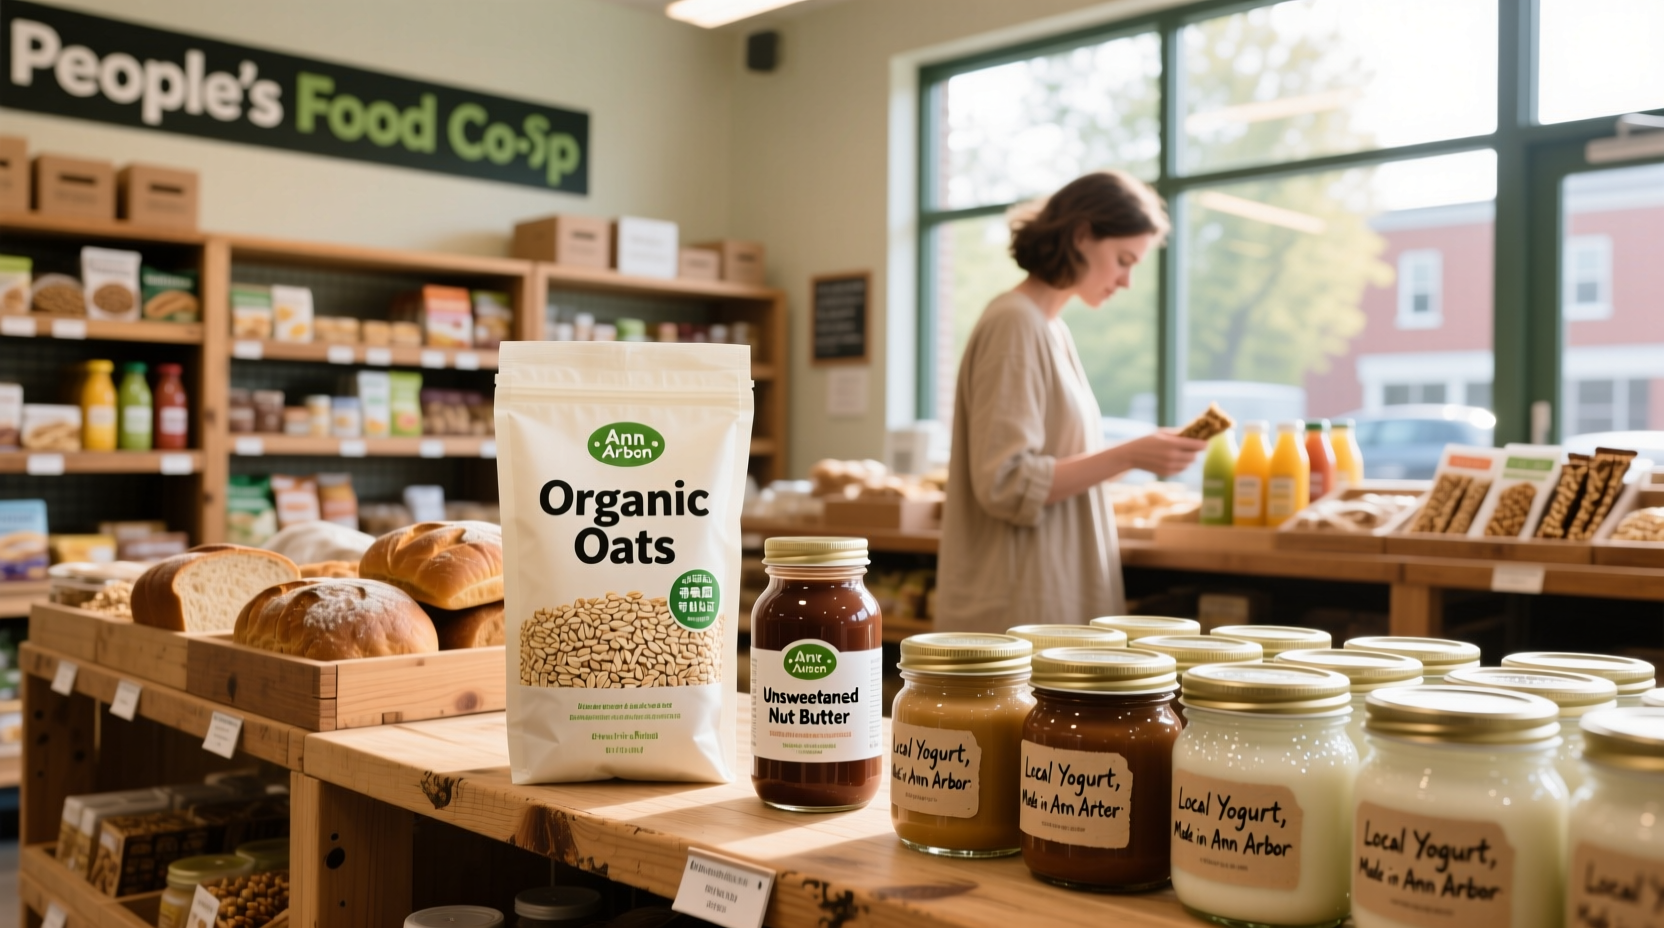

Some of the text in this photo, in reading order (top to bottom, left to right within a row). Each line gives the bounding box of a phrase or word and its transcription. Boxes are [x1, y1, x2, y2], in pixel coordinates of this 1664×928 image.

[9, 17, 285, 129] People's
[297, 71, 437, 155] Food
[605, 428, 645, 446] Ann
[539, 479, 710, 527] Organic
[574, 526, 676, 565] Oats
[763, 686, 859, 704] Unsweetaned
[768, 707, 851, 725] Nut Butter
[916, 739, 970, 771] Yogurt,
[1058, 762, 1121, 797] Yogurt,
[1178, 786, 1287, 832] Local Yogurt,
[1196, 828, 1207, 847] in
[1210, 828, 1238, 852] Ann
[1242, 832, 1293, 857] Arbor
[1363, 819, 1498, 873] Local Yogurt,
[1402, 867, 1436, 894] Ann
